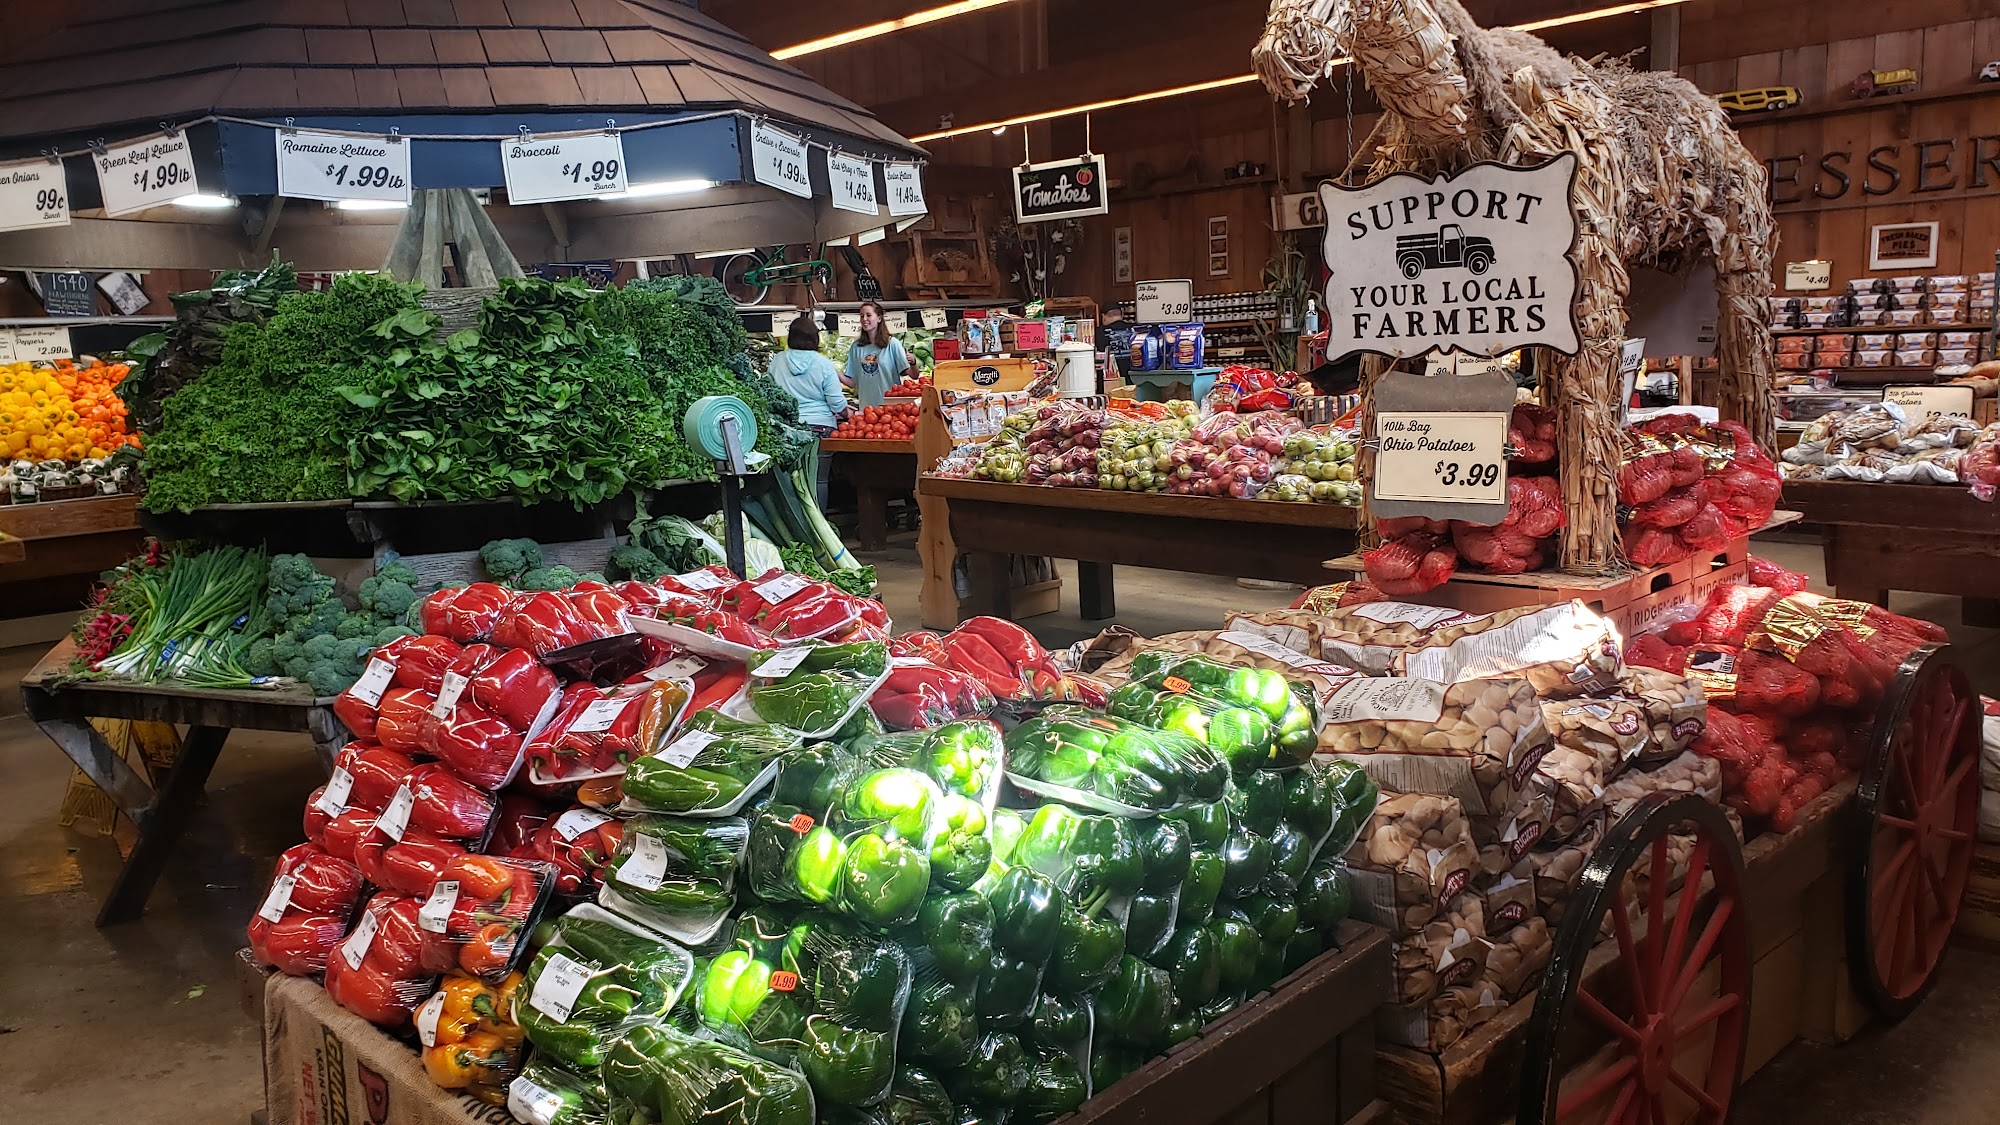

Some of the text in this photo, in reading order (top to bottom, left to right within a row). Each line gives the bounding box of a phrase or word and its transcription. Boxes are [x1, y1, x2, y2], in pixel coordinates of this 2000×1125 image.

[100, 141, 183, 174] Green Leaf Lettuce
[283, 139, 386, 158] Romaine Lettuce
[511, 145, 560, 158] Broccoli
[13, 172, 40, 184] Onions
[562, 159, 619, 183] $1.99
[594, 182, 616, 190] Bunch
[1022, 174, 1090, 208] Tomatoes
[36, 188, 64, 211] 99¢
[43, 211, 61, 220] Bunch
[1347, 188, 1542, 241] SUPPORT
[1892, 240, 1916, 249] PIES
[52, 274, 88, 292] 1940
[1350, 275, 1546, 308] YOUR LOCAL
[1162, 303, 1188, 314] $3.99
[1352, 304, 1546, 339] FARMERS
[974, 370, 998, 383] Marzetti
[1384, 420, 1432, 435] 10lb Bag
[1383, 436, 1476, 452] Ohio Potatoes
[1435, 460, 1499, 487] $3.99
[772, 975, 795, 988] $1.99
[315, 1048, 326, 1088] MAIN
[301, 1062, 316, 1105] NET
